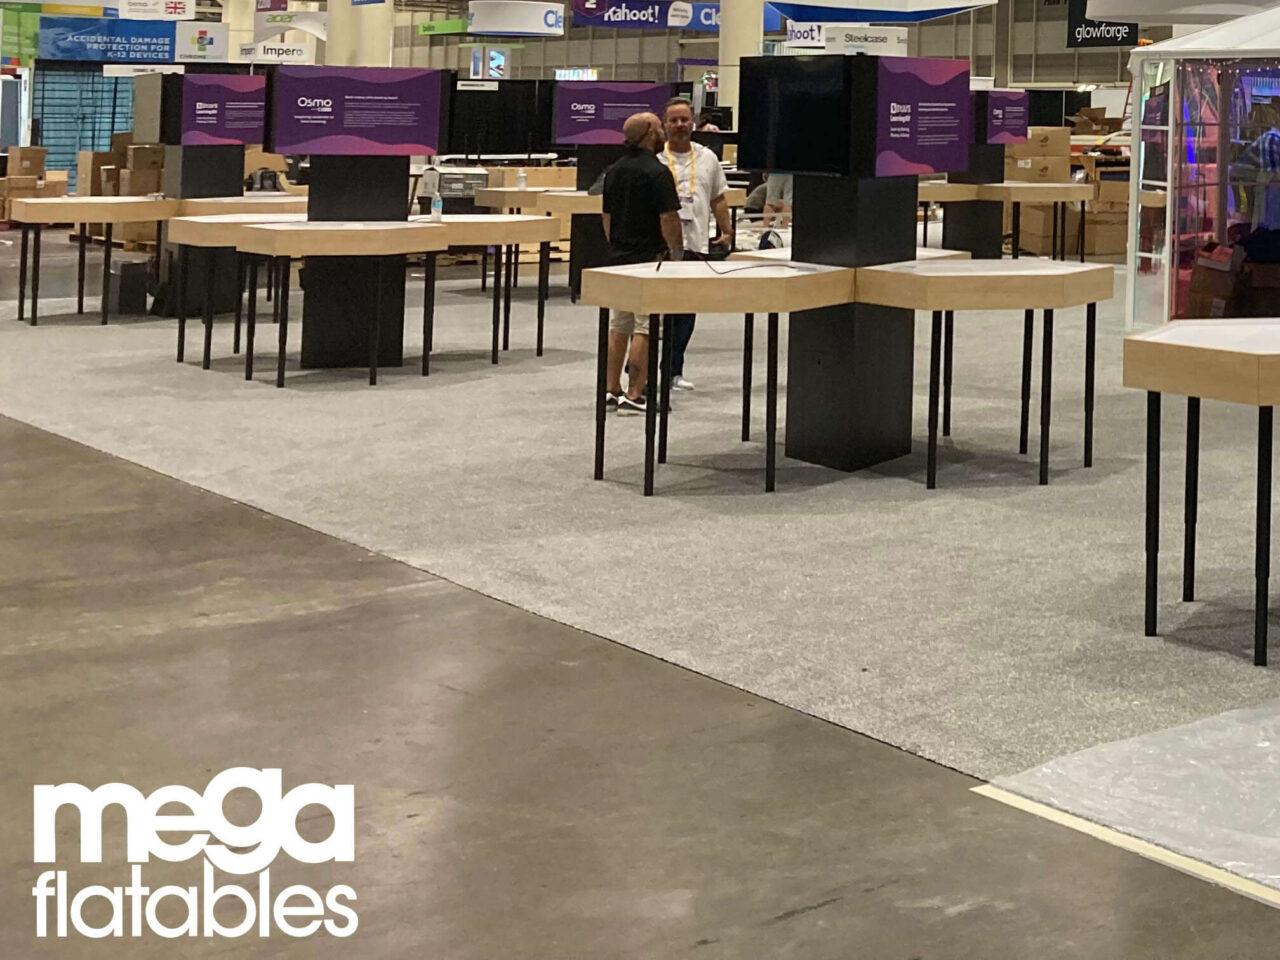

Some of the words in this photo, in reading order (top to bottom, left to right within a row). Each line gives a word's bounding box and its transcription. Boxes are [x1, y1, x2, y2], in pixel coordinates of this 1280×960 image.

[604, 3, 660, 23] Kahoot!
[265, 14, 297, 23] acer
[1075, 21, 1130, 42] glowforge
[66, 35, 127, 44] ACCIDENTAL
[844, 33, 888, 44] Steelcase
[86, 44, 148, 52] PROTECTION
[263, 46, 304, 58] Impero
[297, 97, 332, 107] Osmo
[571, 103, 596, 111] Osmo
